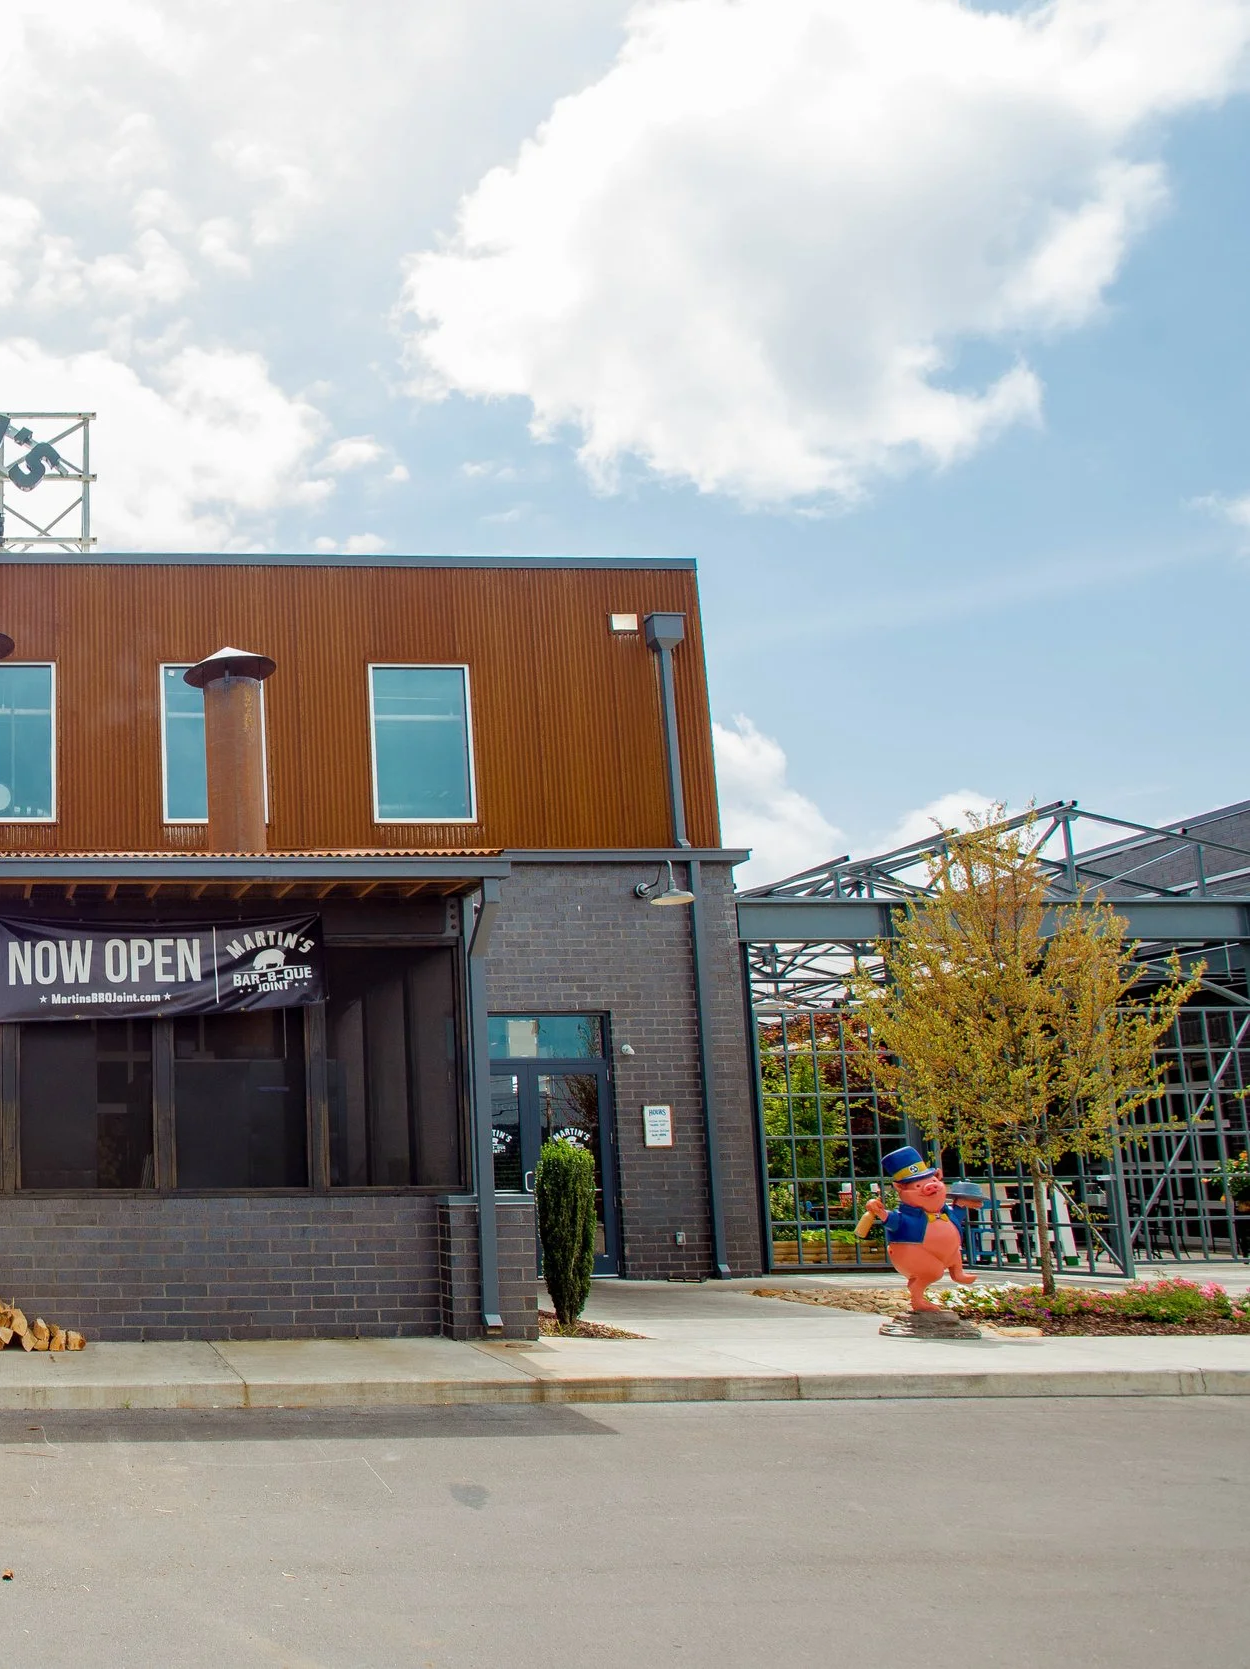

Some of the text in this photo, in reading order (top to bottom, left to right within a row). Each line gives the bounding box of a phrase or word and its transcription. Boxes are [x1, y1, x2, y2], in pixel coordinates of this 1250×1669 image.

[225, 930, 315, 959] MARTIN'S
[7, 937, 202, 986] NOW OPEN
[233, 966, 313, 987] BAR-B-QUE
[257, 980, 289, 993] JOINT
[51, 992, 161, 1004] MartinsBBQJoint.com
[552, 1127, 591, 1142] MARTIN'S
